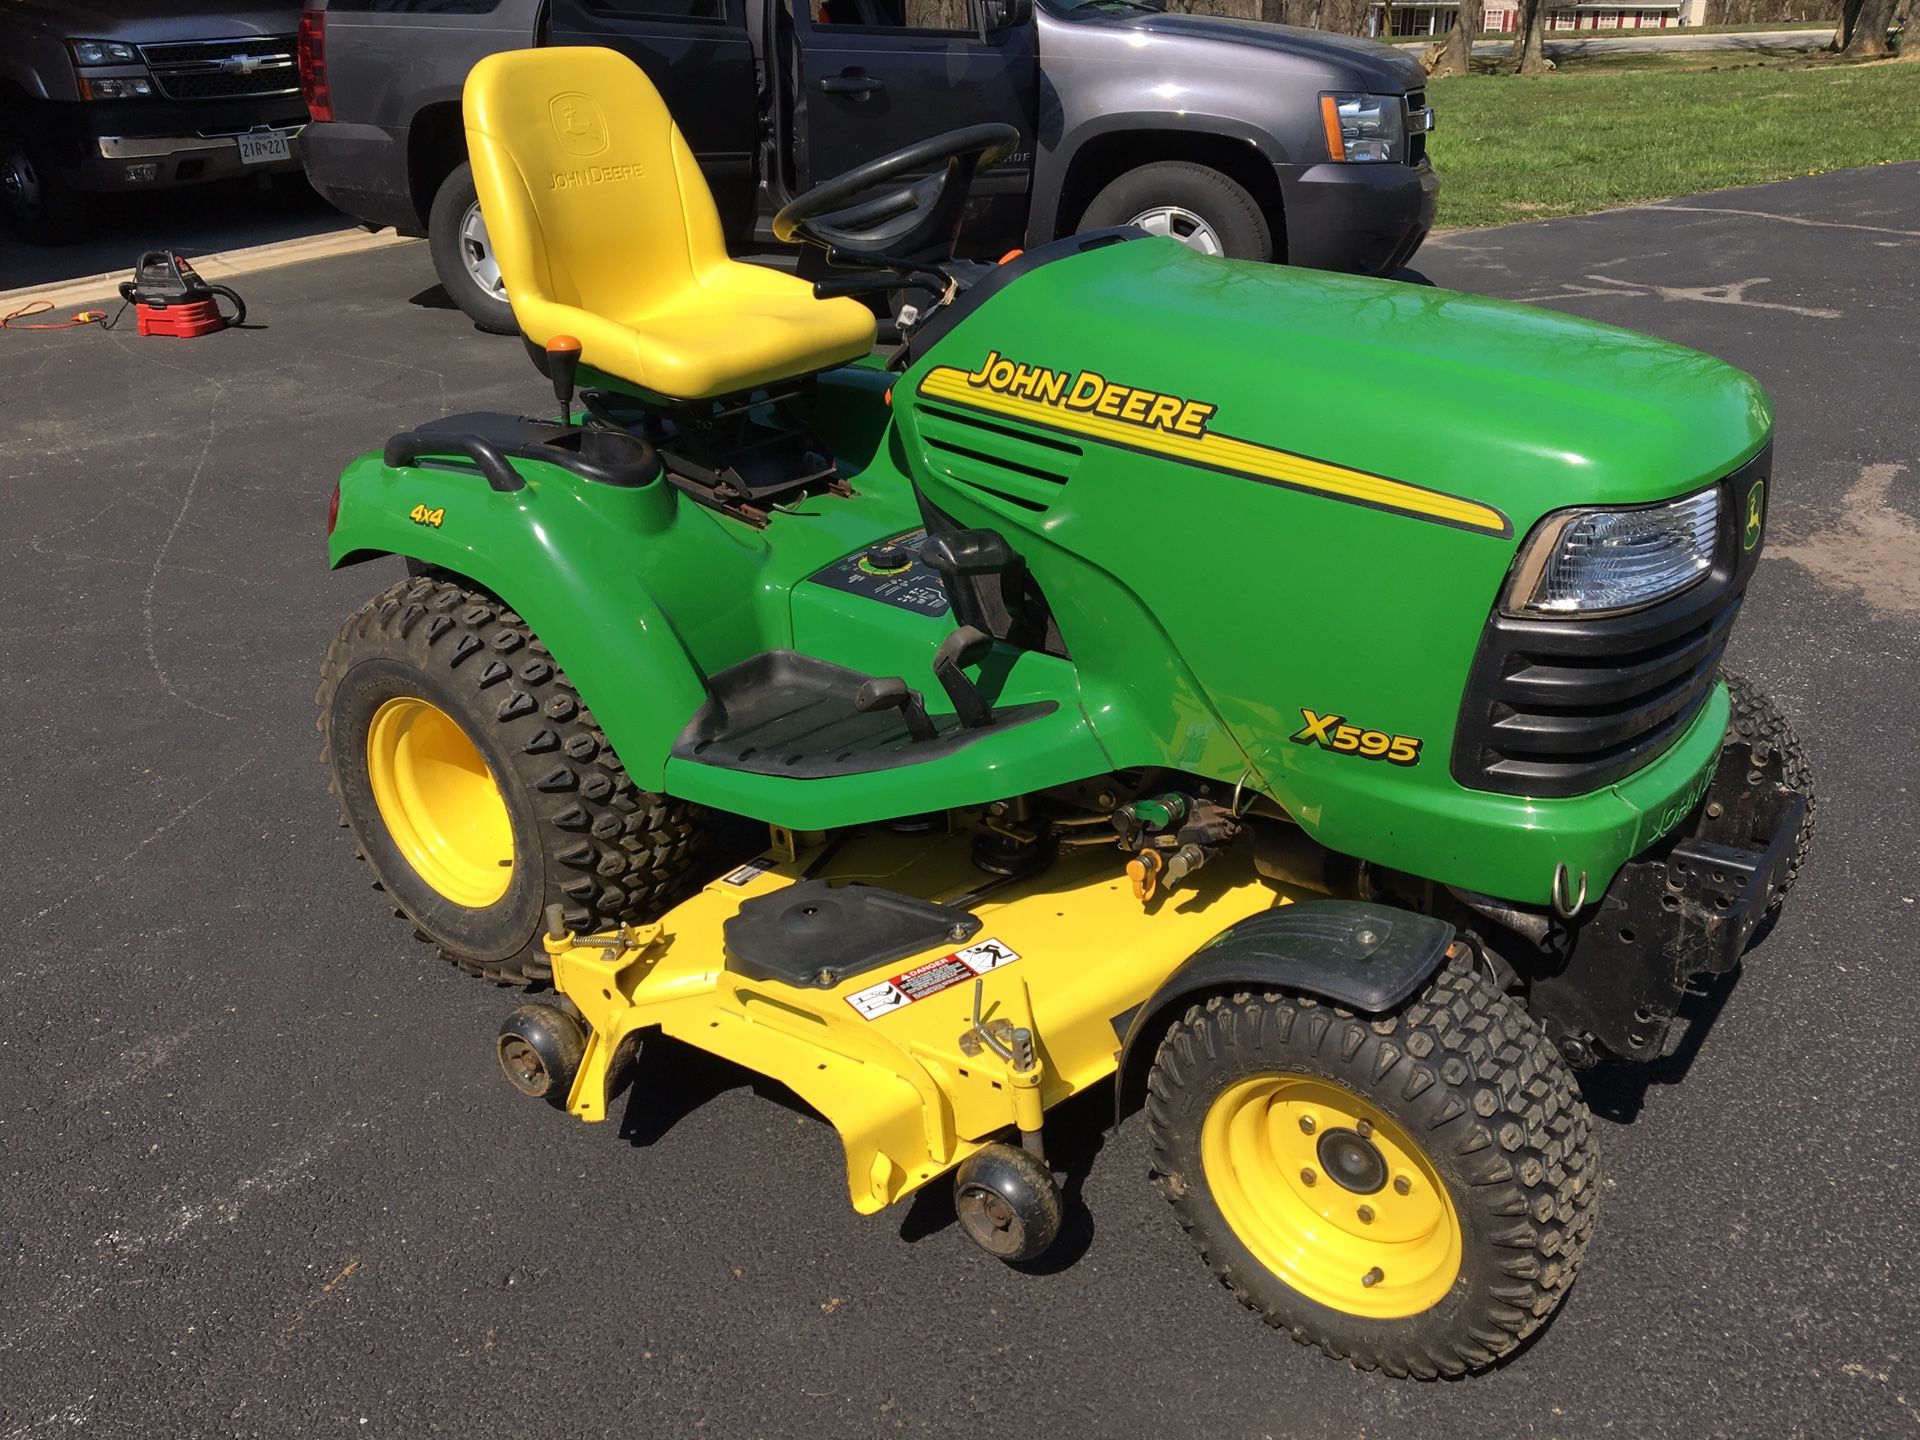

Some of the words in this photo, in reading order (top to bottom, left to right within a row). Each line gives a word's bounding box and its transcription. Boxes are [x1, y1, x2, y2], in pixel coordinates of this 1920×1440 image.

[550, 170, 591, 191] JOHN
[588, 163, 646, 185] DEERE
[967, 350, 1070, 407] JOHN
[1064, 369, 1218, 440] DEERE
[1289, 708, 1424, 767] X595
[908, 957, 949, 977] DANGER
